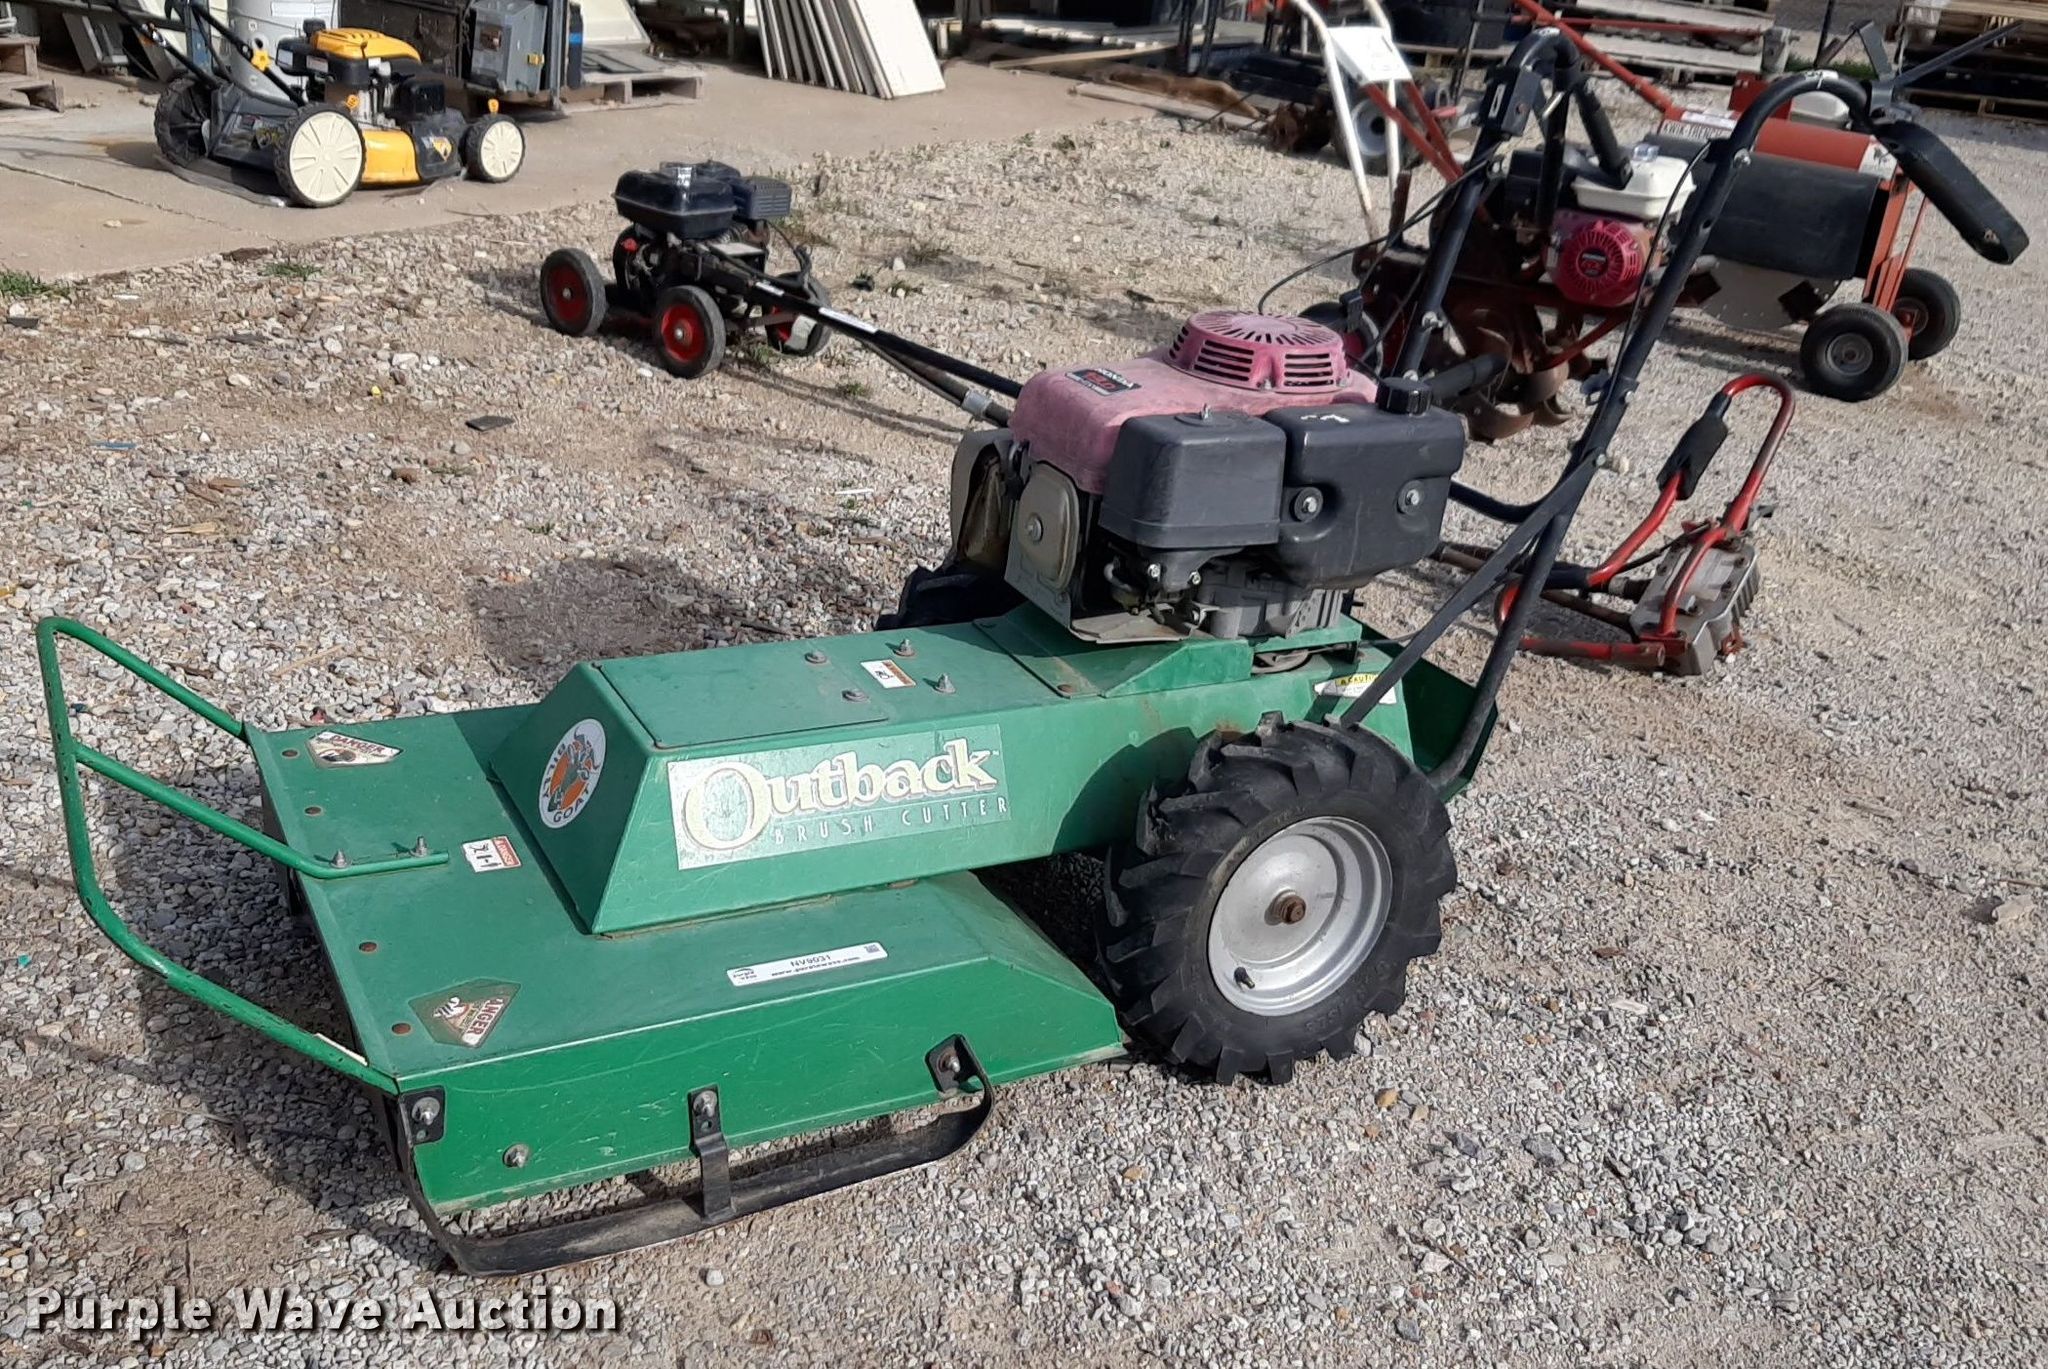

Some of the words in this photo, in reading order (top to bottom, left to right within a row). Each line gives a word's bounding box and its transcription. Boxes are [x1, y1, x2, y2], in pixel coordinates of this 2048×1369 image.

[331, 735, 385, 754] DANGER
[541, 742, 567, 799] BILLY
[682, 738, 998, 851] Outback
[552, 780, 591, 823] GOAT
[774, 814, 873, 845] BRUSH
[901, 796, 1008, 827] CUTTER
